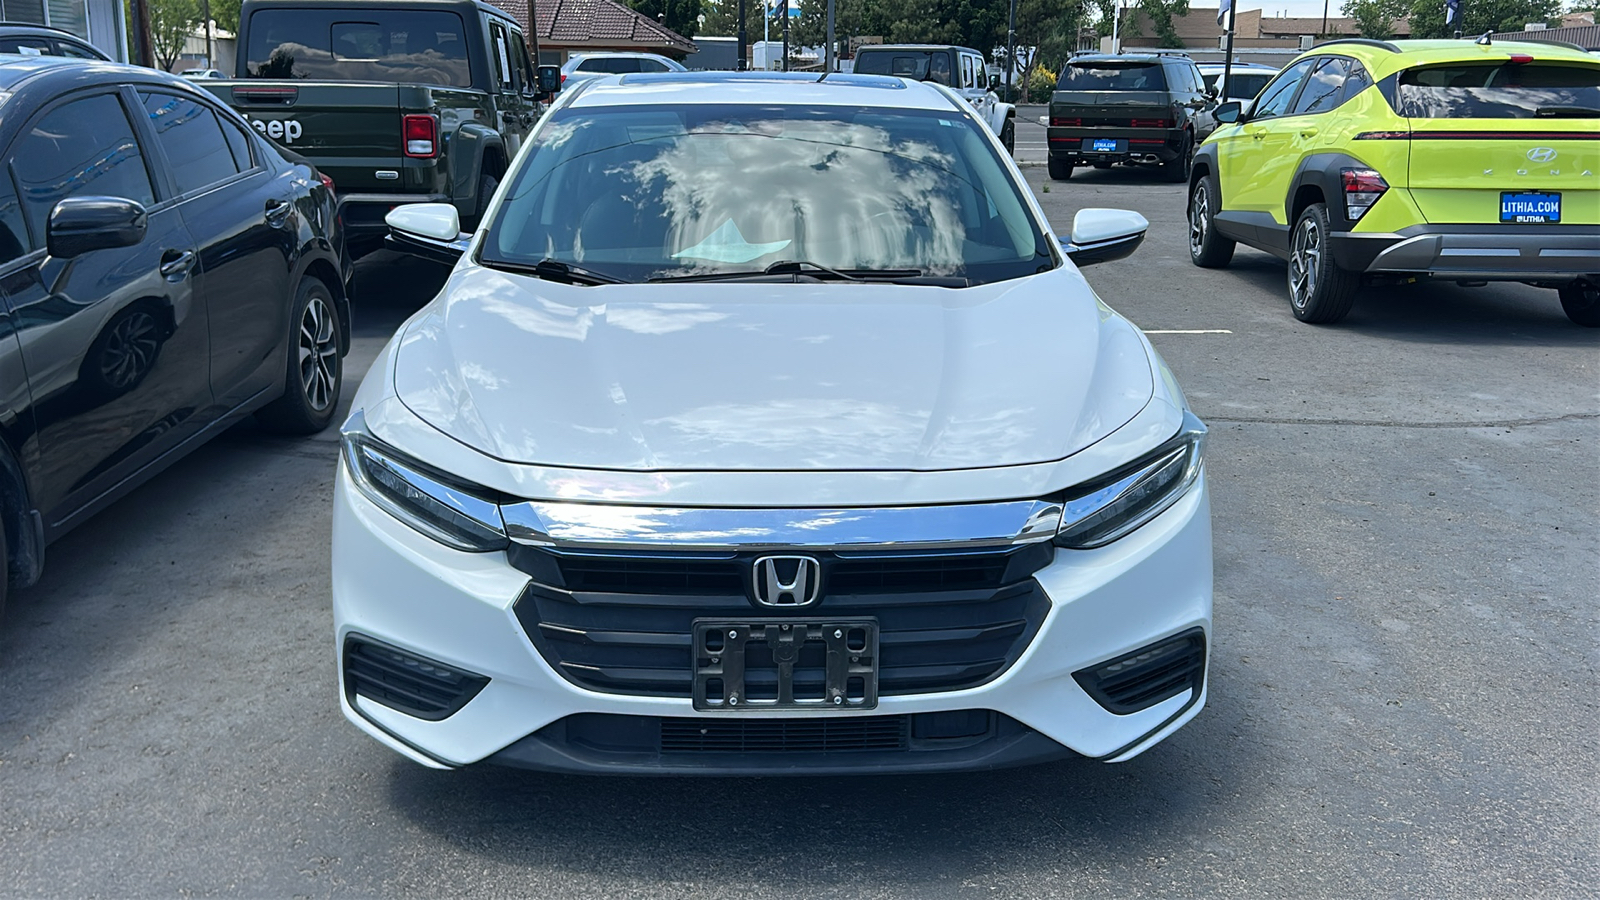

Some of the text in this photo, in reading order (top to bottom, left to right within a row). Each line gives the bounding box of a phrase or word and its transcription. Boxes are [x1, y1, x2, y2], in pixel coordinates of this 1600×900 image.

[242, 114, 302, 144] eep
[1502, 202, 1559, 213] LITHIA.COM
[1523, 215, 1545, 223] LITHIA
